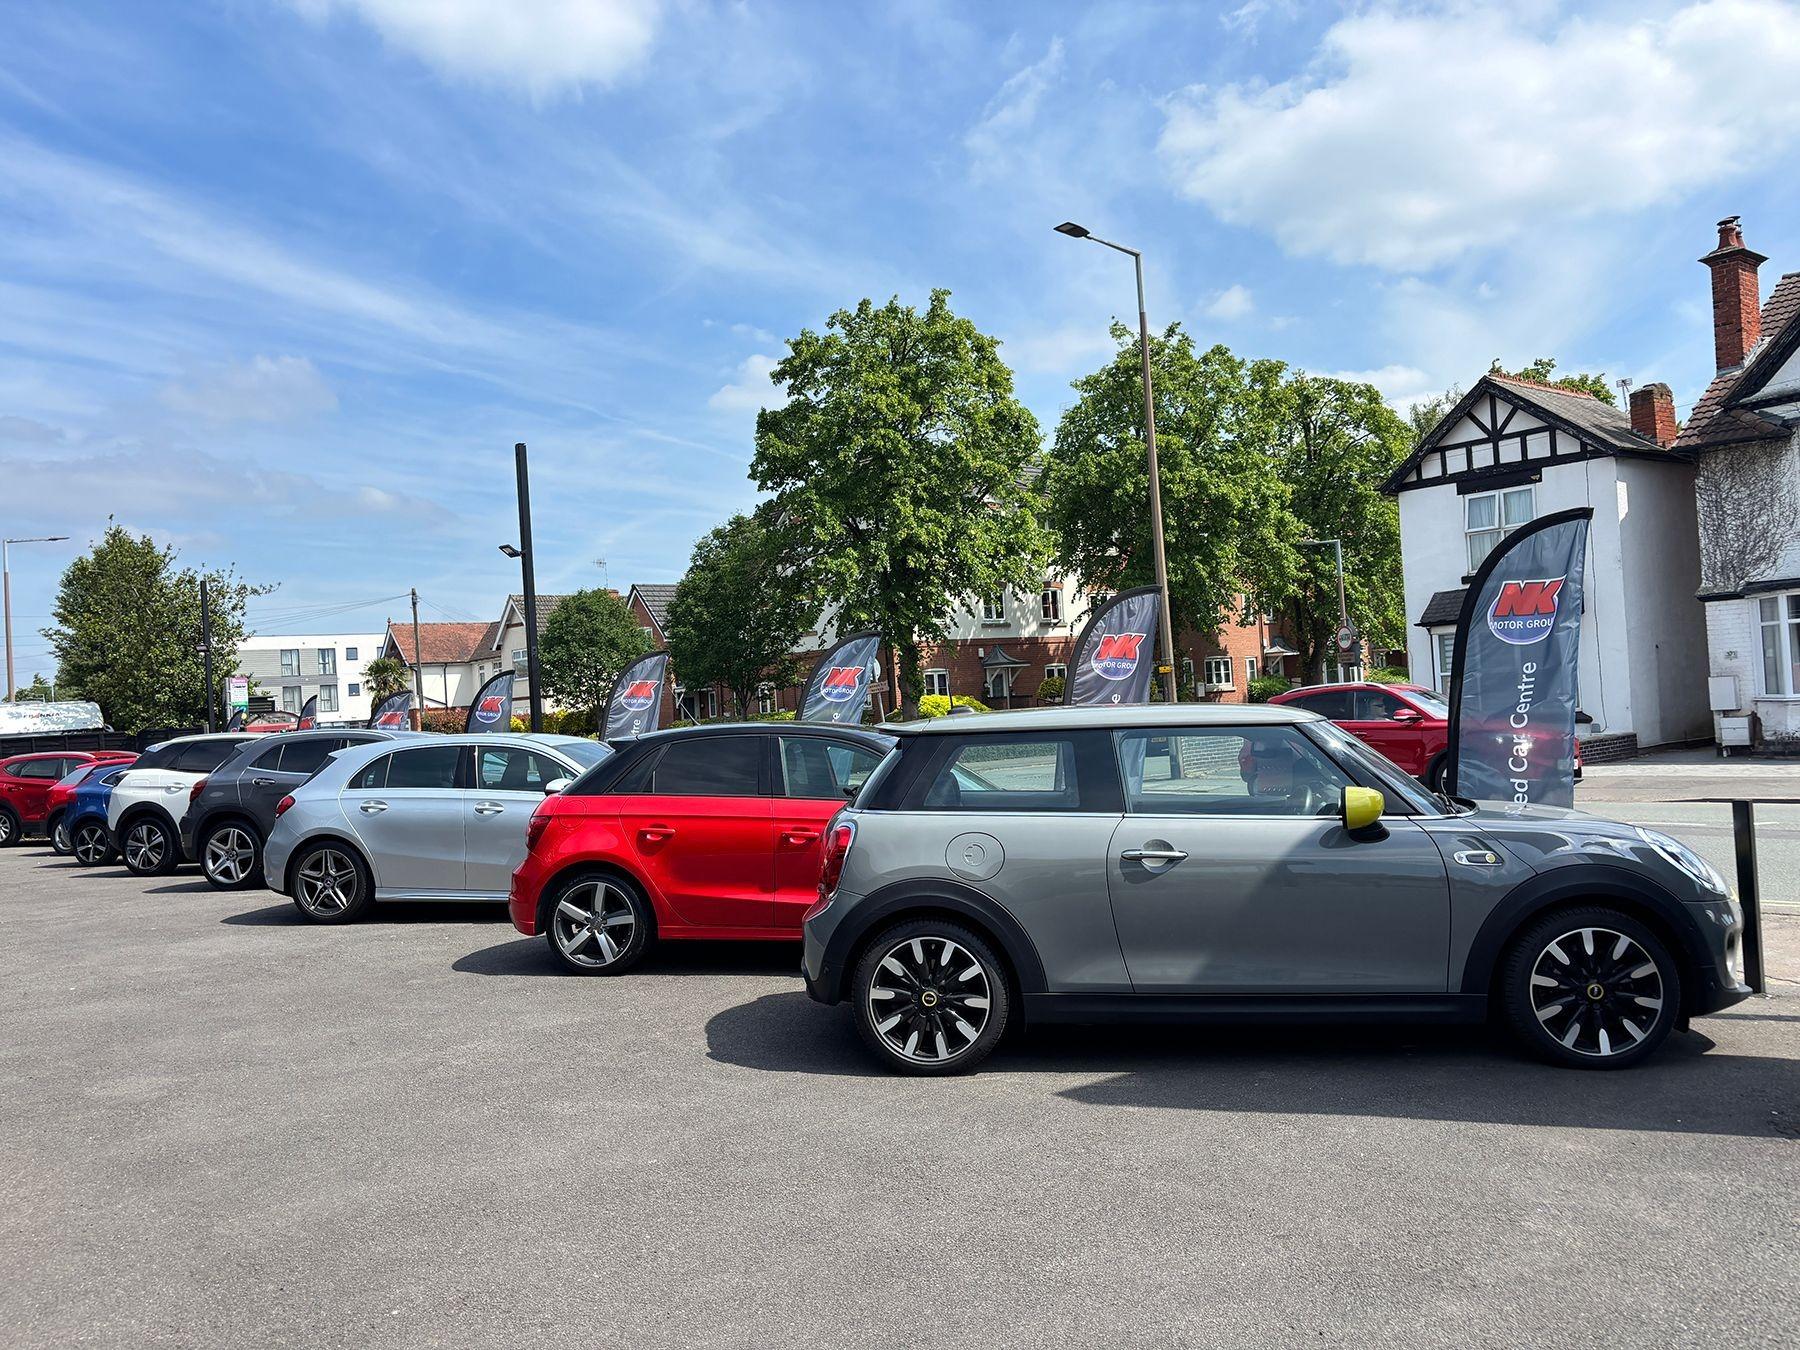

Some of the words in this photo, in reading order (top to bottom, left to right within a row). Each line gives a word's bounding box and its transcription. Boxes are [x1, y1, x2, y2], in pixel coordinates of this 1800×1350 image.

[1492, 578, 1565, 618] NK
[1489, 620, 1523, 630] MOTOR
[1526, 618, 1555, 628] GROU
[1095, 633, 1146, 661] NK
[1510, 661, 1537, 729] Centre
[1508, 733, 1529, 773] Car
